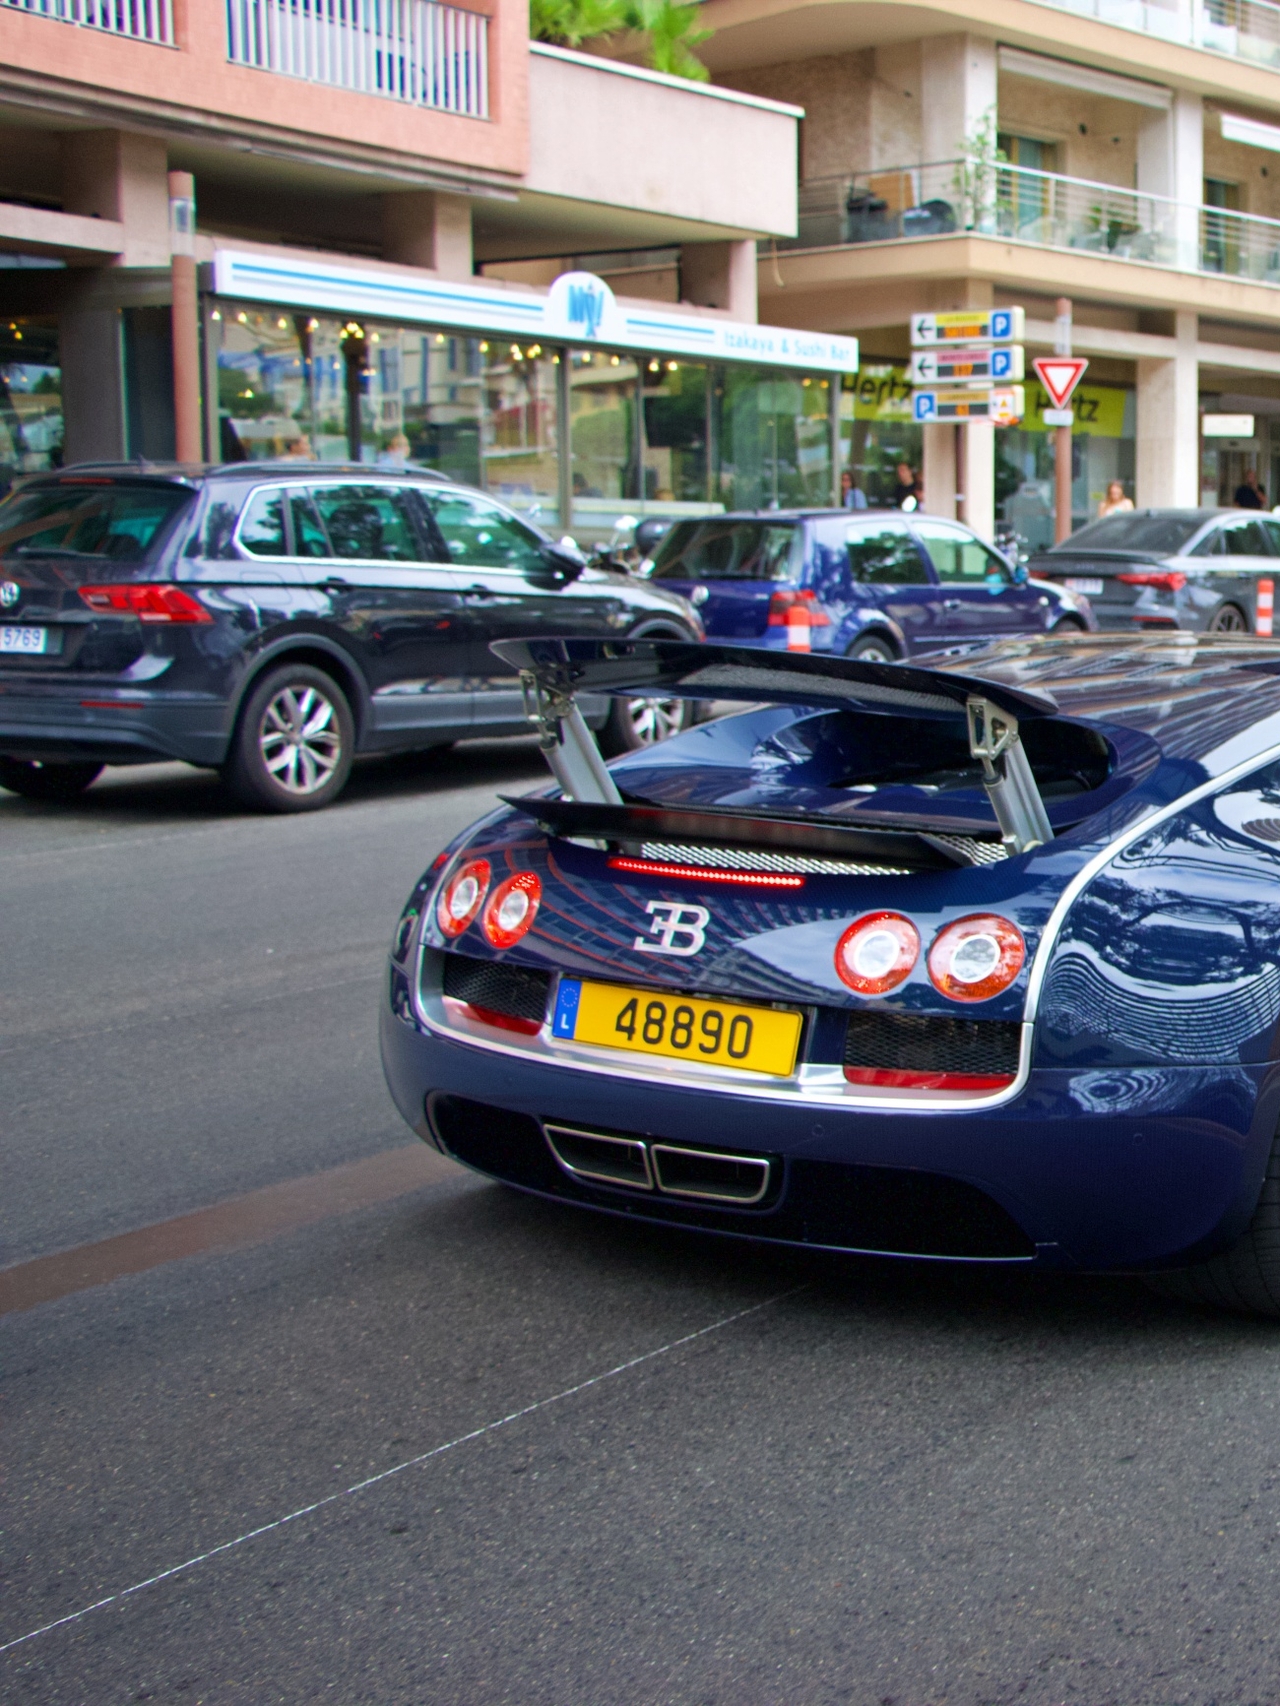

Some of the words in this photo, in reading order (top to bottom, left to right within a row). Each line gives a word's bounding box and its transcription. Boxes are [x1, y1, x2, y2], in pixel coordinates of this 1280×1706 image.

[724, 330, 774, 355] Izakaya
[781, 337, 789, 354] &
[794, 339, 827, 358] Sushi
[830, 344, 850, 360] Bar
[1034, 390, 1099, 422] Htz
[3, 627, 41, 647] 5769
[560, 1013, 570, 1030] L
[615, 997, 753, 1059] 48890
